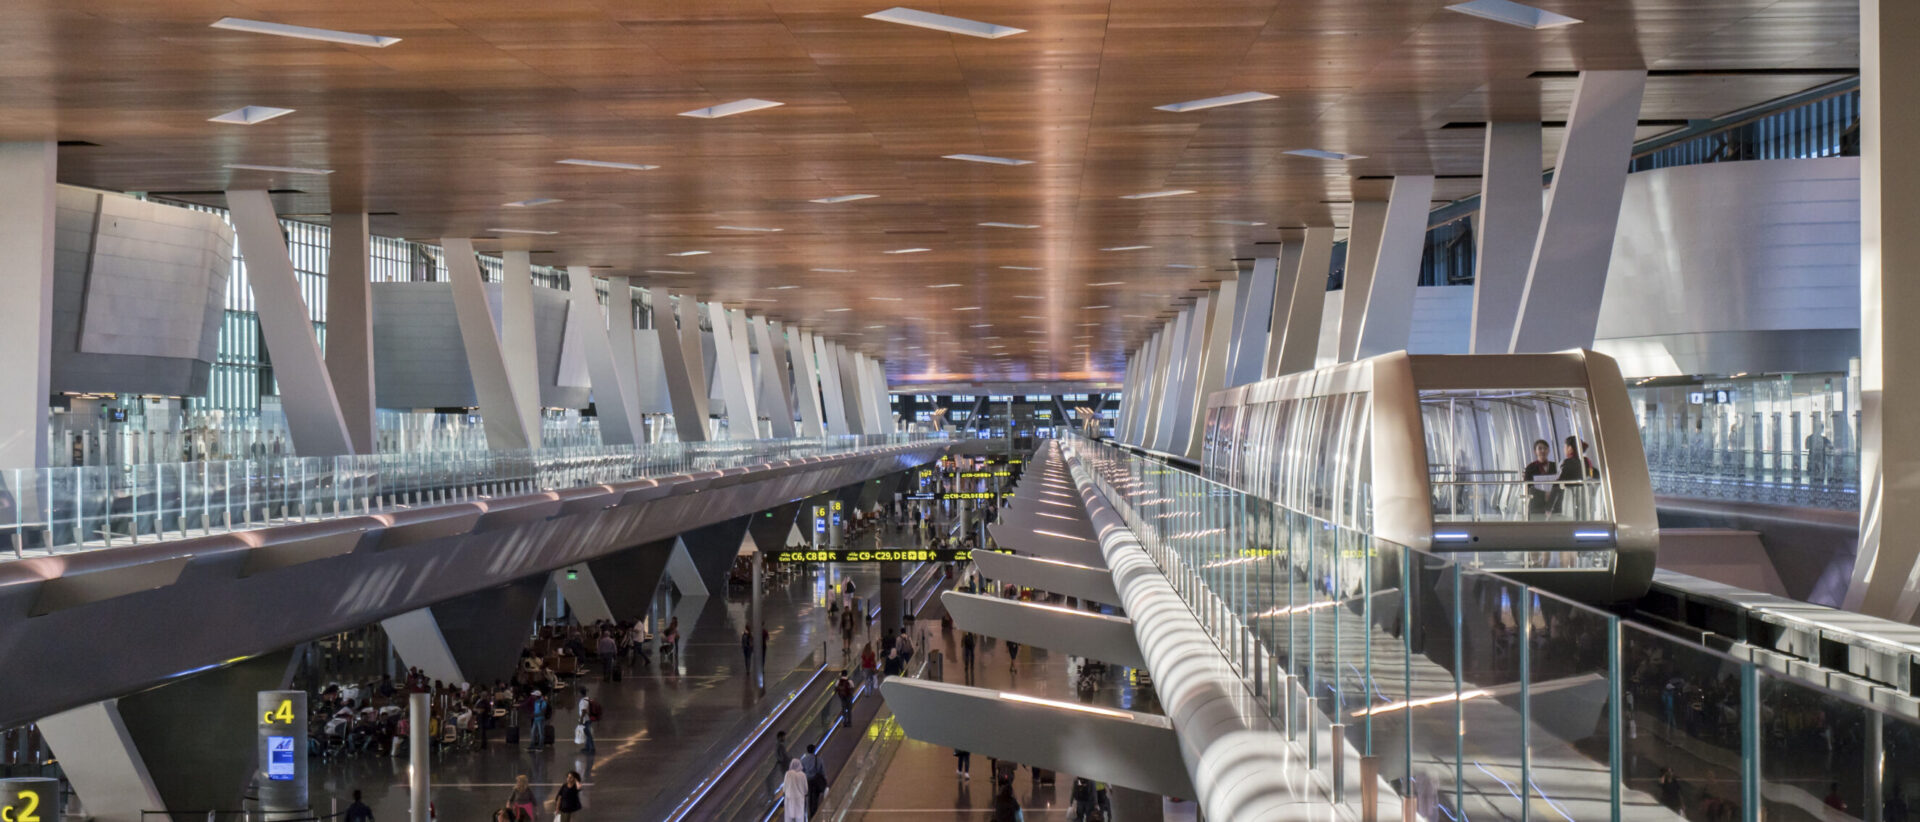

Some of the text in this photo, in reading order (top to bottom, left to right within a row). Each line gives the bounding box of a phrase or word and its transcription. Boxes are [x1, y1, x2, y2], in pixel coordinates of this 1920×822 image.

[805, 552, 817, 561] C8
[264, 699, 295, 725] C4
[1, 789, 40, 822] C2
